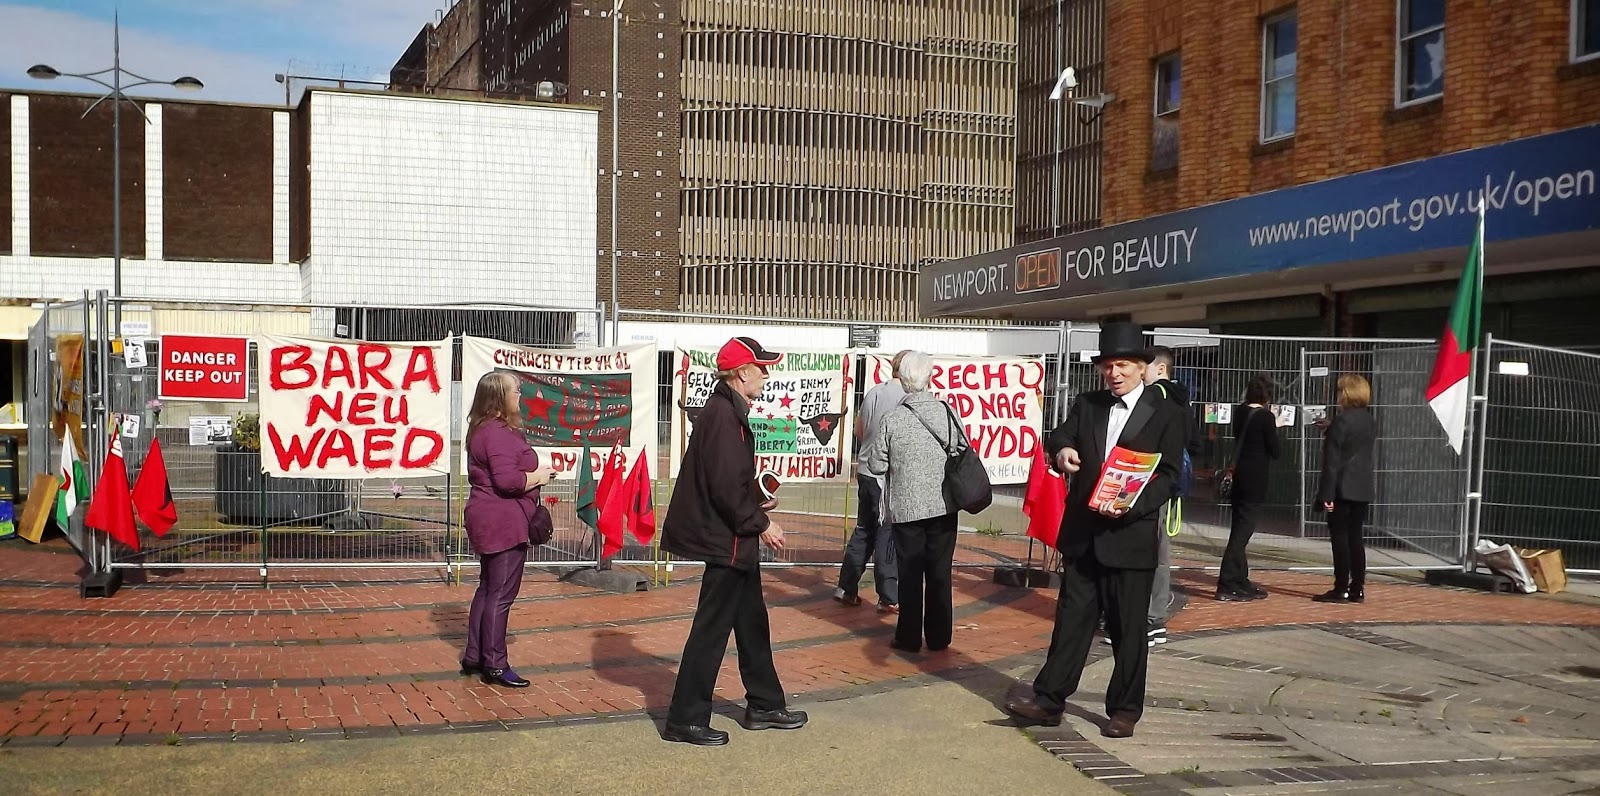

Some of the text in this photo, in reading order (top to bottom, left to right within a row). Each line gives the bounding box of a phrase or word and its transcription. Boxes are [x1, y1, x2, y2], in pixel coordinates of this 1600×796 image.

[1249, 169, 1595, 247] www.newport.gov.uk/open
[932, 227, 1199, 302] NEWPORT. OPEN FOR BEAUTY
[171, 351, 237, 366] DANGER
[555, 355, 563, 370] Y
[689, 349, 718, 368] TREC
[787, 353, 841, 371] ARGLWYDD
[164, 369, 243, 384] KEEP OUT
[269, 344, 442, 393] BARA
[928, 363, 1008, 390] RECH
[688, 371, 718, 389] GELY
[763, 380, 796, 392] SANS
[800, 378, 832, 389] ENEMY
[801, 391, 831, 403] OF ALL
[978, 392, 1026, 420] NAG
[305, 391, 410, 427] NEU
[752, 423, 768, 431] AND
[267, 422, 444, 472] WAED
[965, 424, 1037, 459] WYDD
[787, 456, 836, 478] WAED
